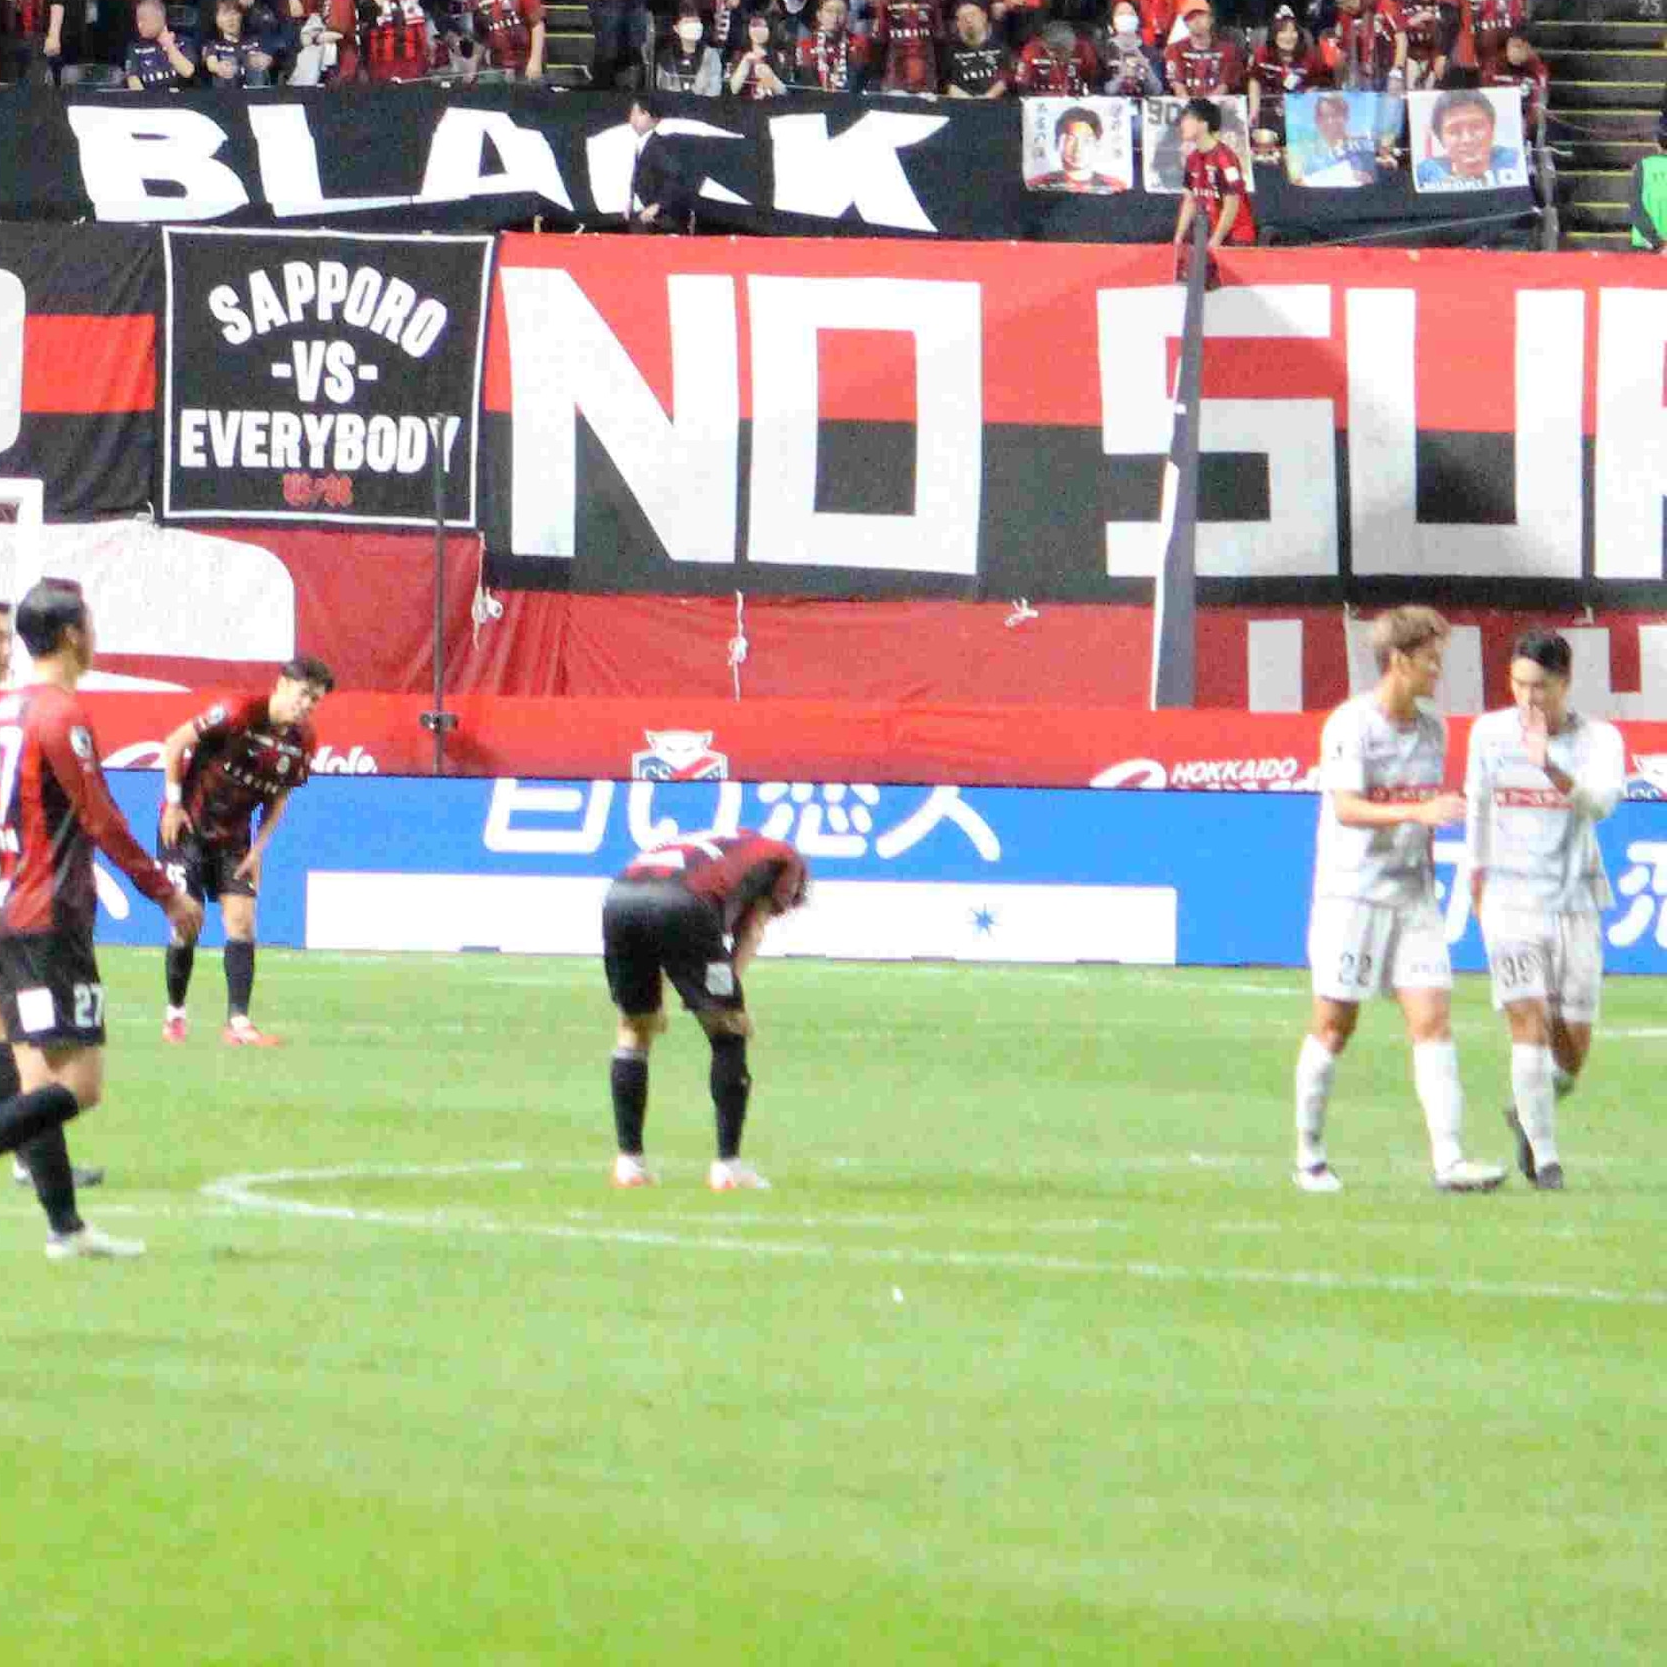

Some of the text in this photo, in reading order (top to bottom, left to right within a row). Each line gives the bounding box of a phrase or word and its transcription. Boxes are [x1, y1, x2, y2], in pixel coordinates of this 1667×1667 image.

[67, 100, 951, 234] BLACK
[207, 260, 448, 359] SAPPORO
[179, 407, 461, 474] EVERYBODY
[500, 266, 982, 575] NO
[1169, 757, 1300, 784] HOKKAIDO
[74, 983, 108, 1029] 27
